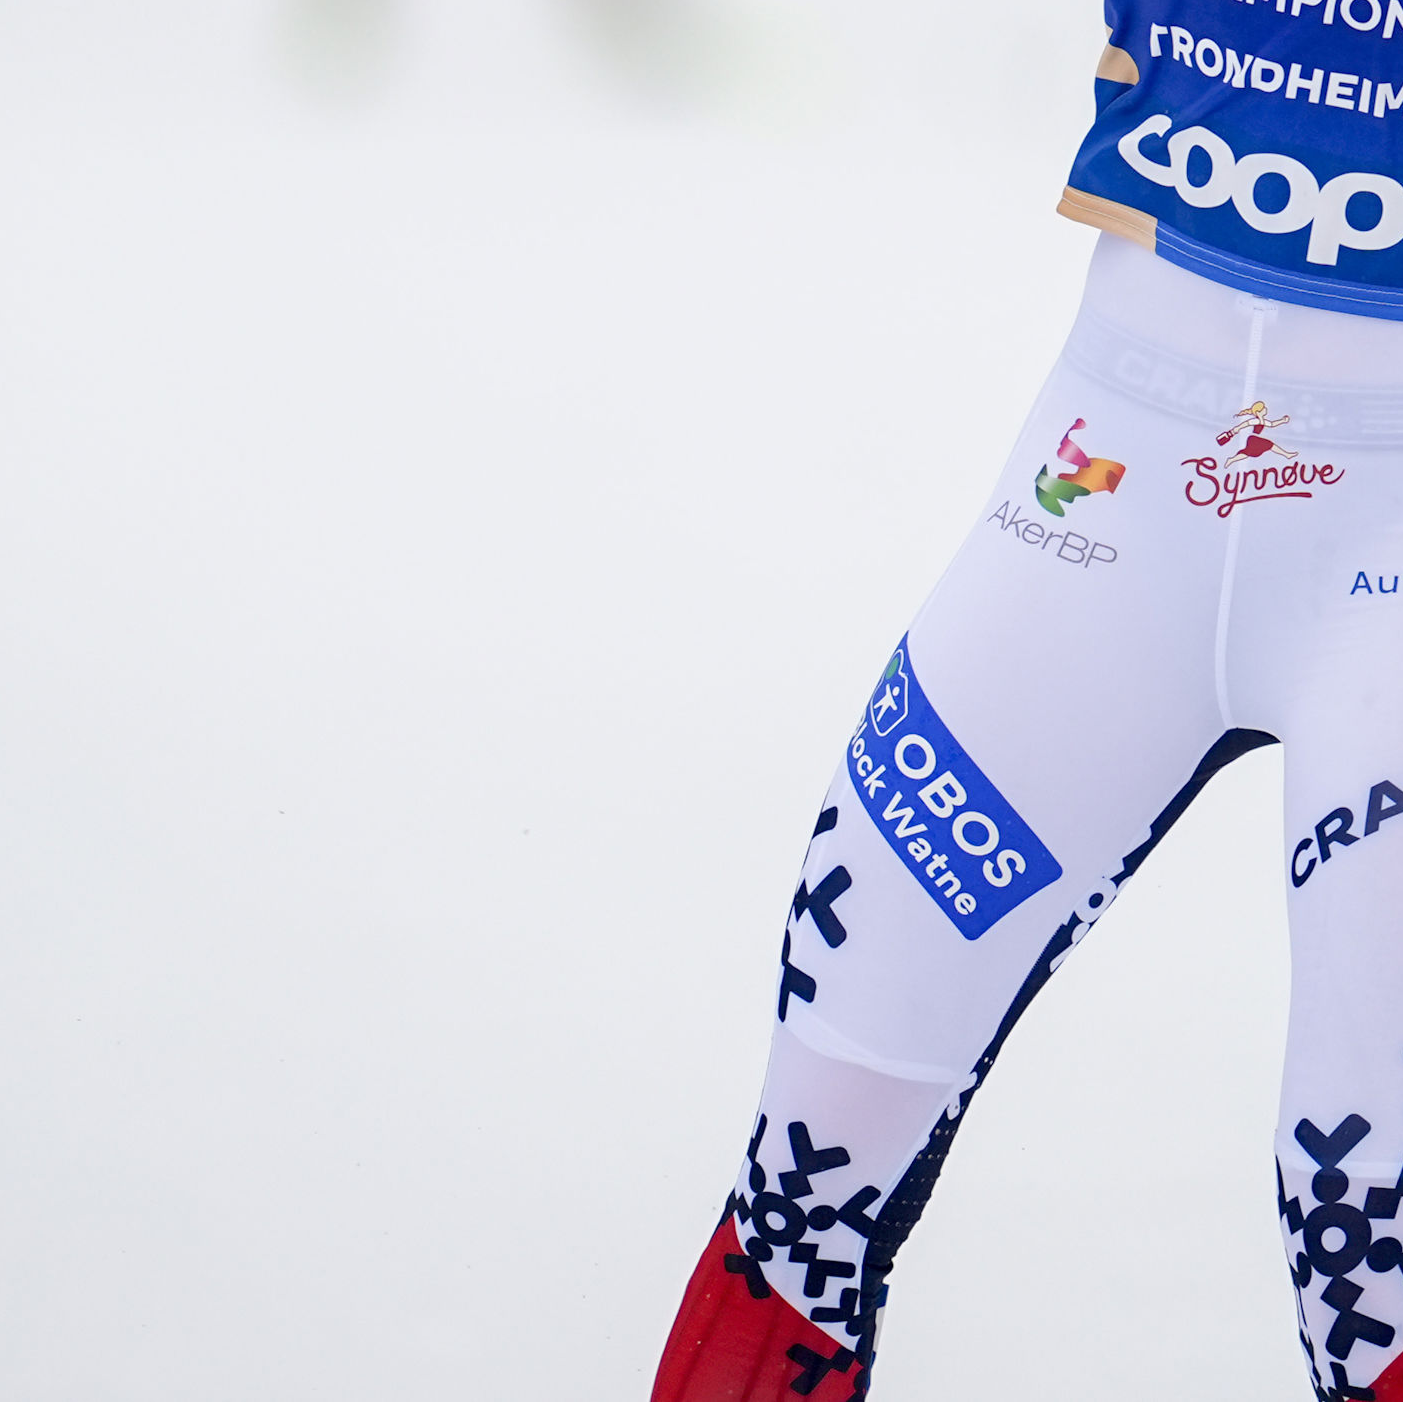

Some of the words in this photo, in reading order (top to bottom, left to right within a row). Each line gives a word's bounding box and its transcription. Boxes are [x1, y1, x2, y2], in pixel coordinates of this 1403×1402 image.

[986, 500, 1118, 569] AkerBP
[1180, 457, 1346, 519] Synnøve
[851, 716, 887, 799] lock
[881, 791, 977, 916] Watne
[894, 733, 1027, 888] OBOS
